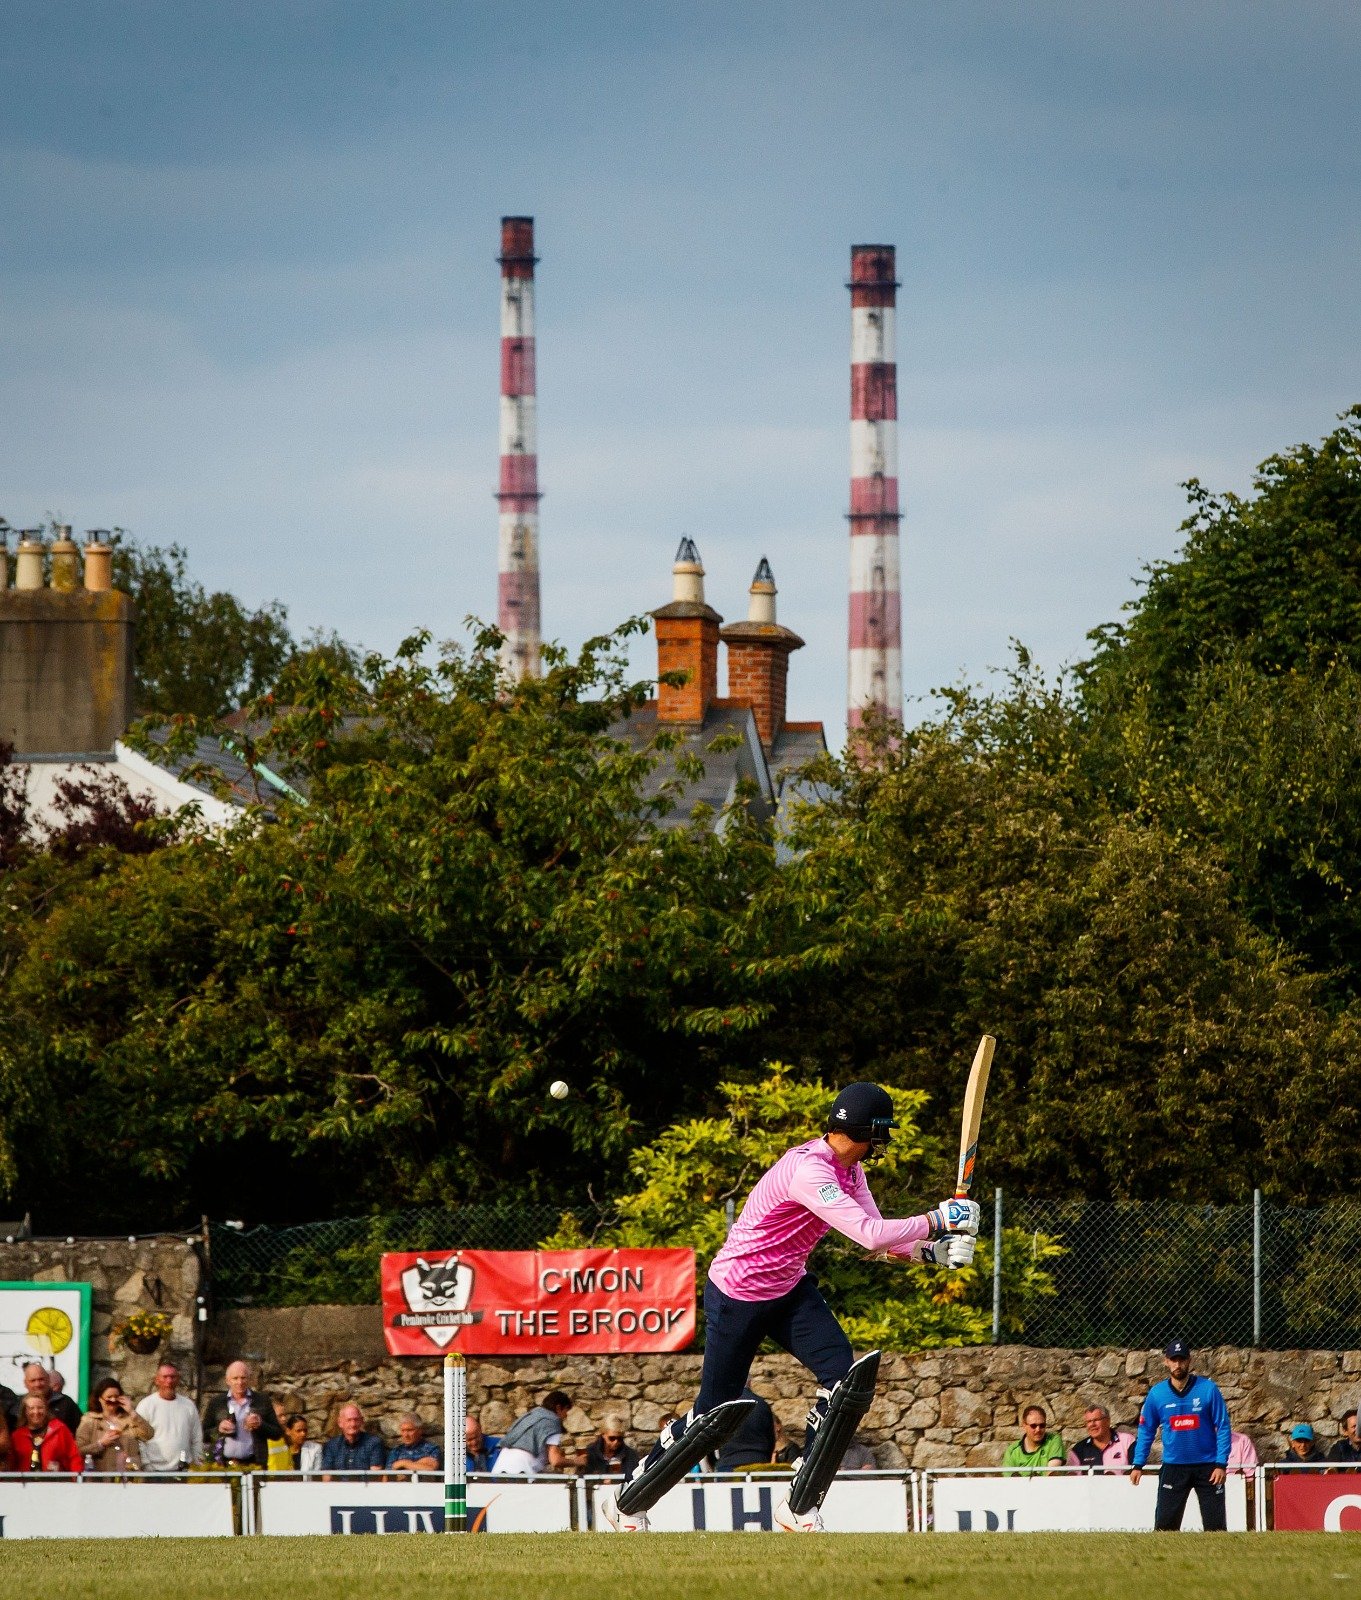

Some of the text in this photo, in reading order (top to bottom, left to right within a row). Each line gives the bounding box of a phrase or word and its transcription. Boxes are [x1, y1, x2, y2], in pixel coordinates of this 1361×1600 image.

[539, 1266, 644, 1294] C'MON
[495, 1307, 687, 1336] THE BROOK
